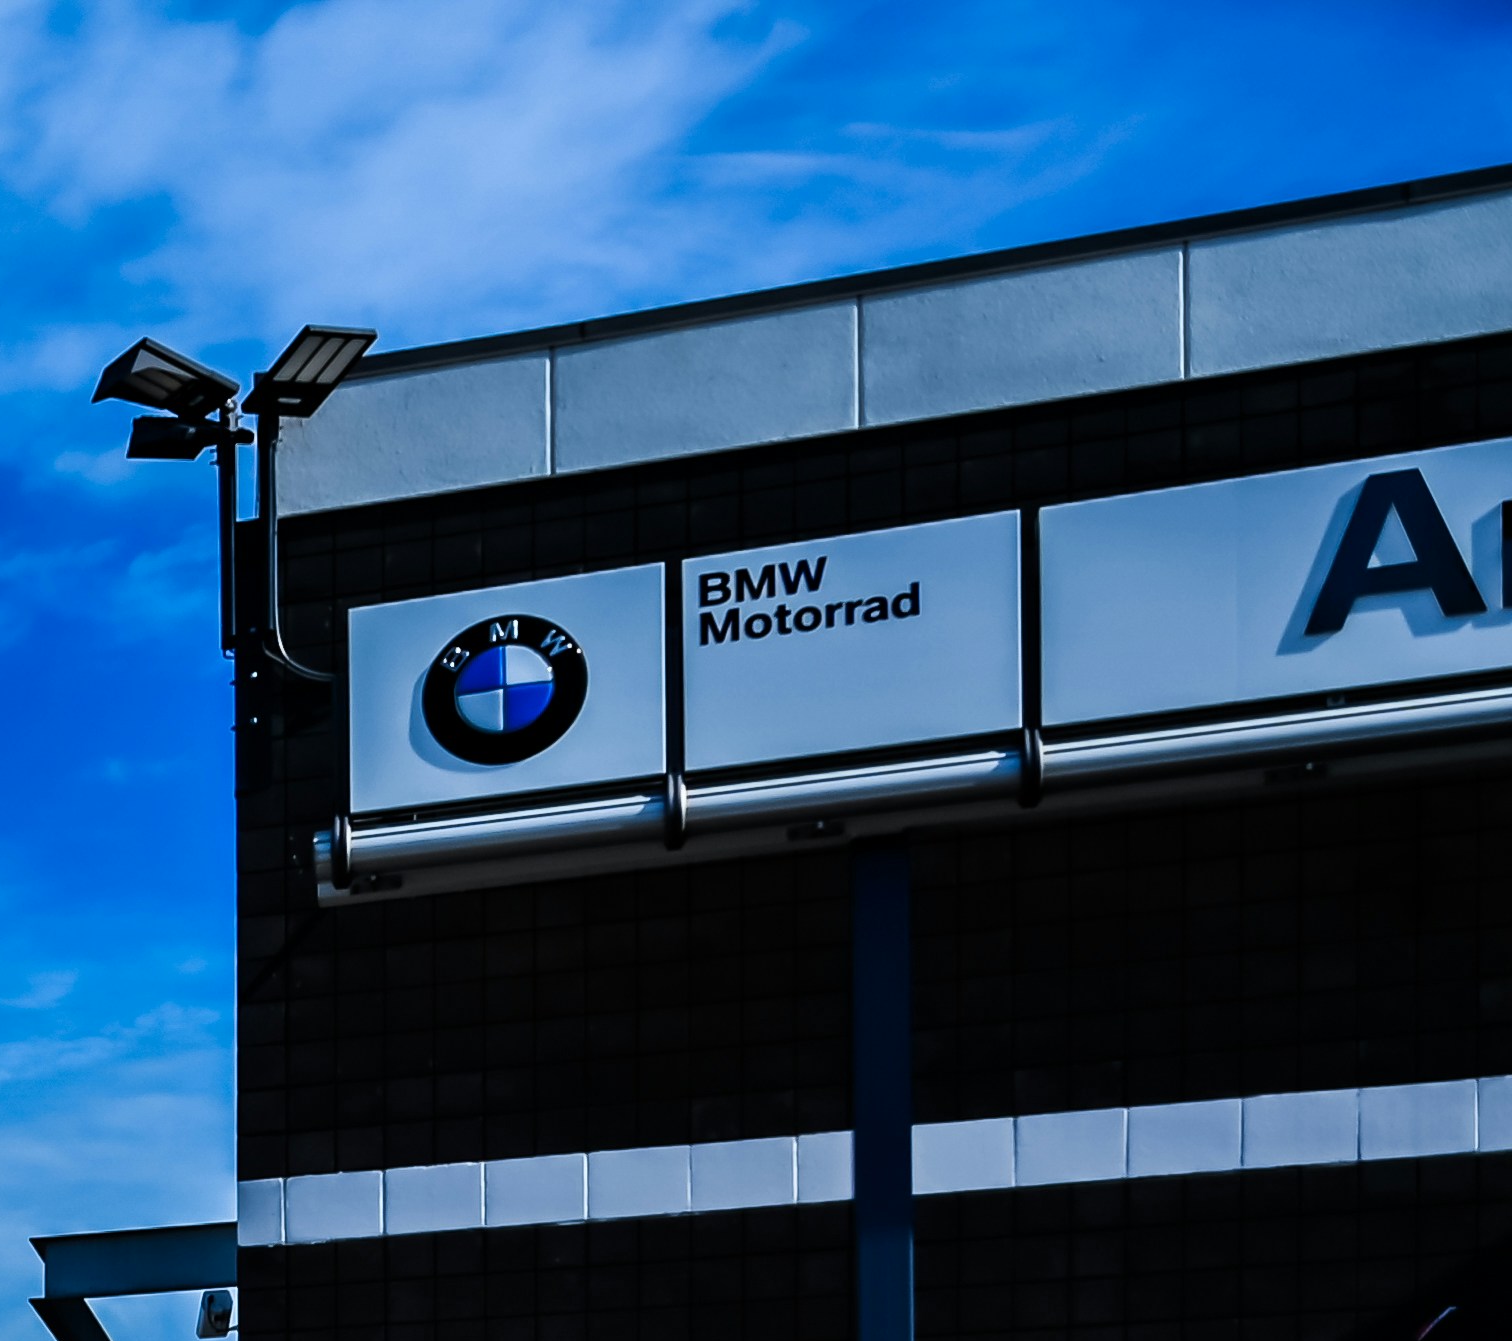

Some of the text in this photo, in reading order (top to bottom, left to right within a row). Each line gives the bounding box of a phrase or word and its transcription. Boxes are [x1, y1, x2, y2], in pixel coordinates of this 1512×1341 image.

[697, 556, 828, 608] BMW
[698, 582, 921, 646] Motorrad
[442, 618, 581, 670] BMW
